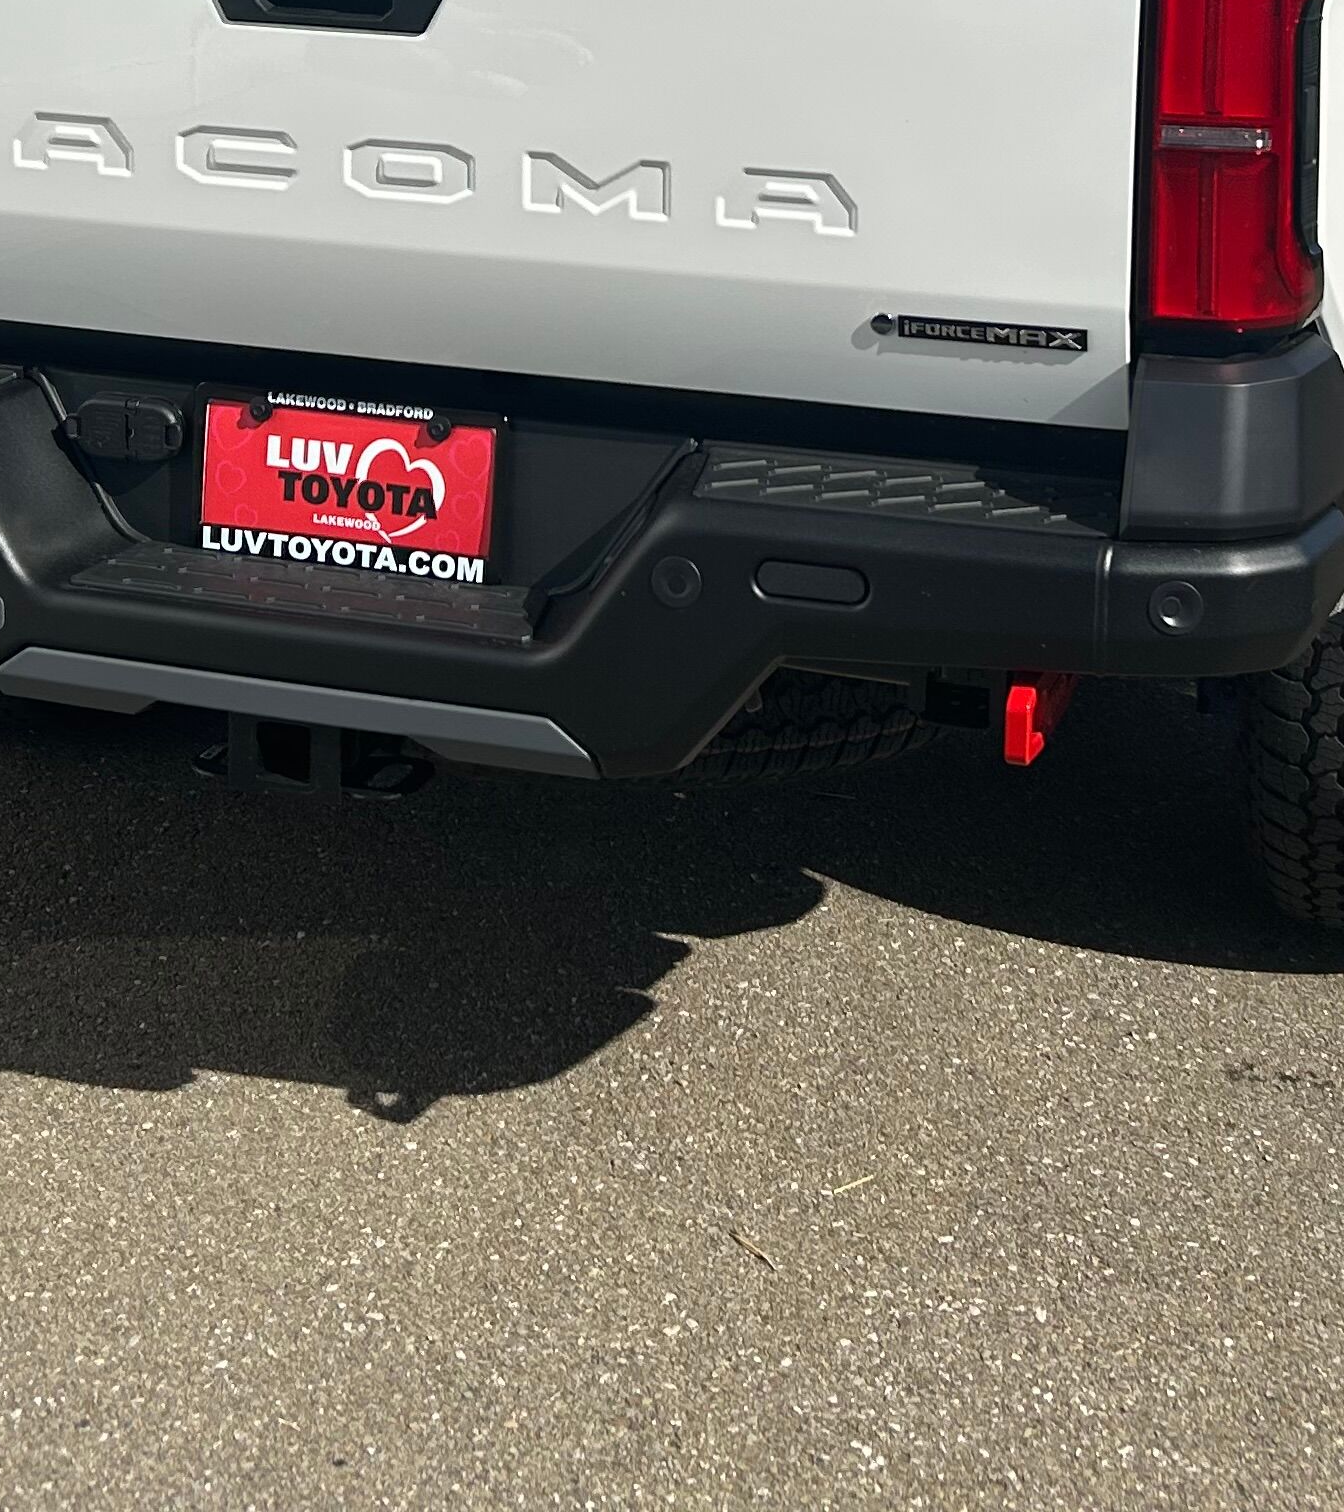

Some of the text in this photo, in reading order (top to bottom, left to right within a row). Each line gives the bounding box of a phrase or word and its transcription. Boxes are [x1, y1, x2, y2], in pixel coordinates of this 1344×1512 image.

[267, 391, 434, 420] LAKEWOOD BRADFORD
[266, 434, 354, 476] LUV
[278, 470, 437, 520] TOYOTA
[312, 513, 381, 531] LAKEWOOD
[202, 525, 484, 584] LUVTOYOTA.COM
